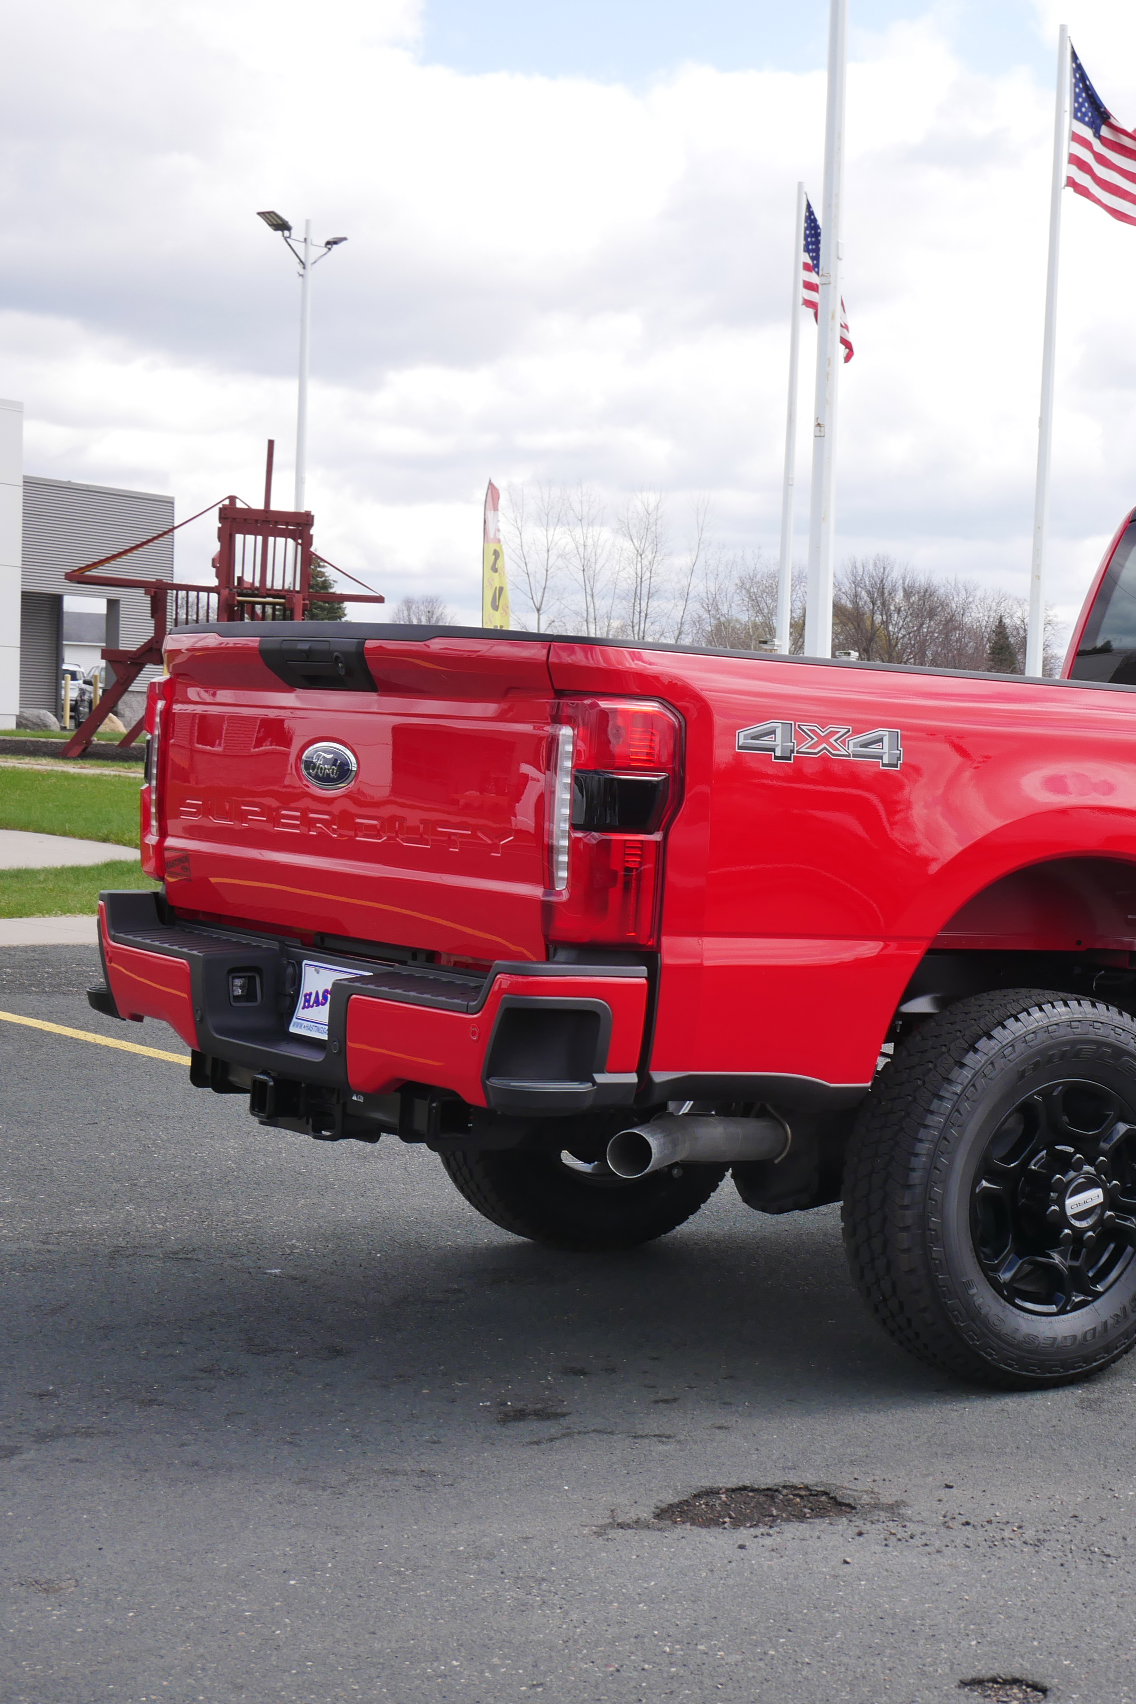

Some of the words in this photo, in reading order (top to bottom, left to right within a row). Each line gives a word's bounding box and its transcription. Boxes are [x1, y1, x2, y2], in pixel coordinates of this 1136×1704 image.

[309, 751, 341, 779] Ford
[179, 798, 341, 838] SUPER
[353, 818, 515, 857] DUTY
[301, 988, 332, 1010] HAS
[1070, 1194, 1100, 1210] FORD
